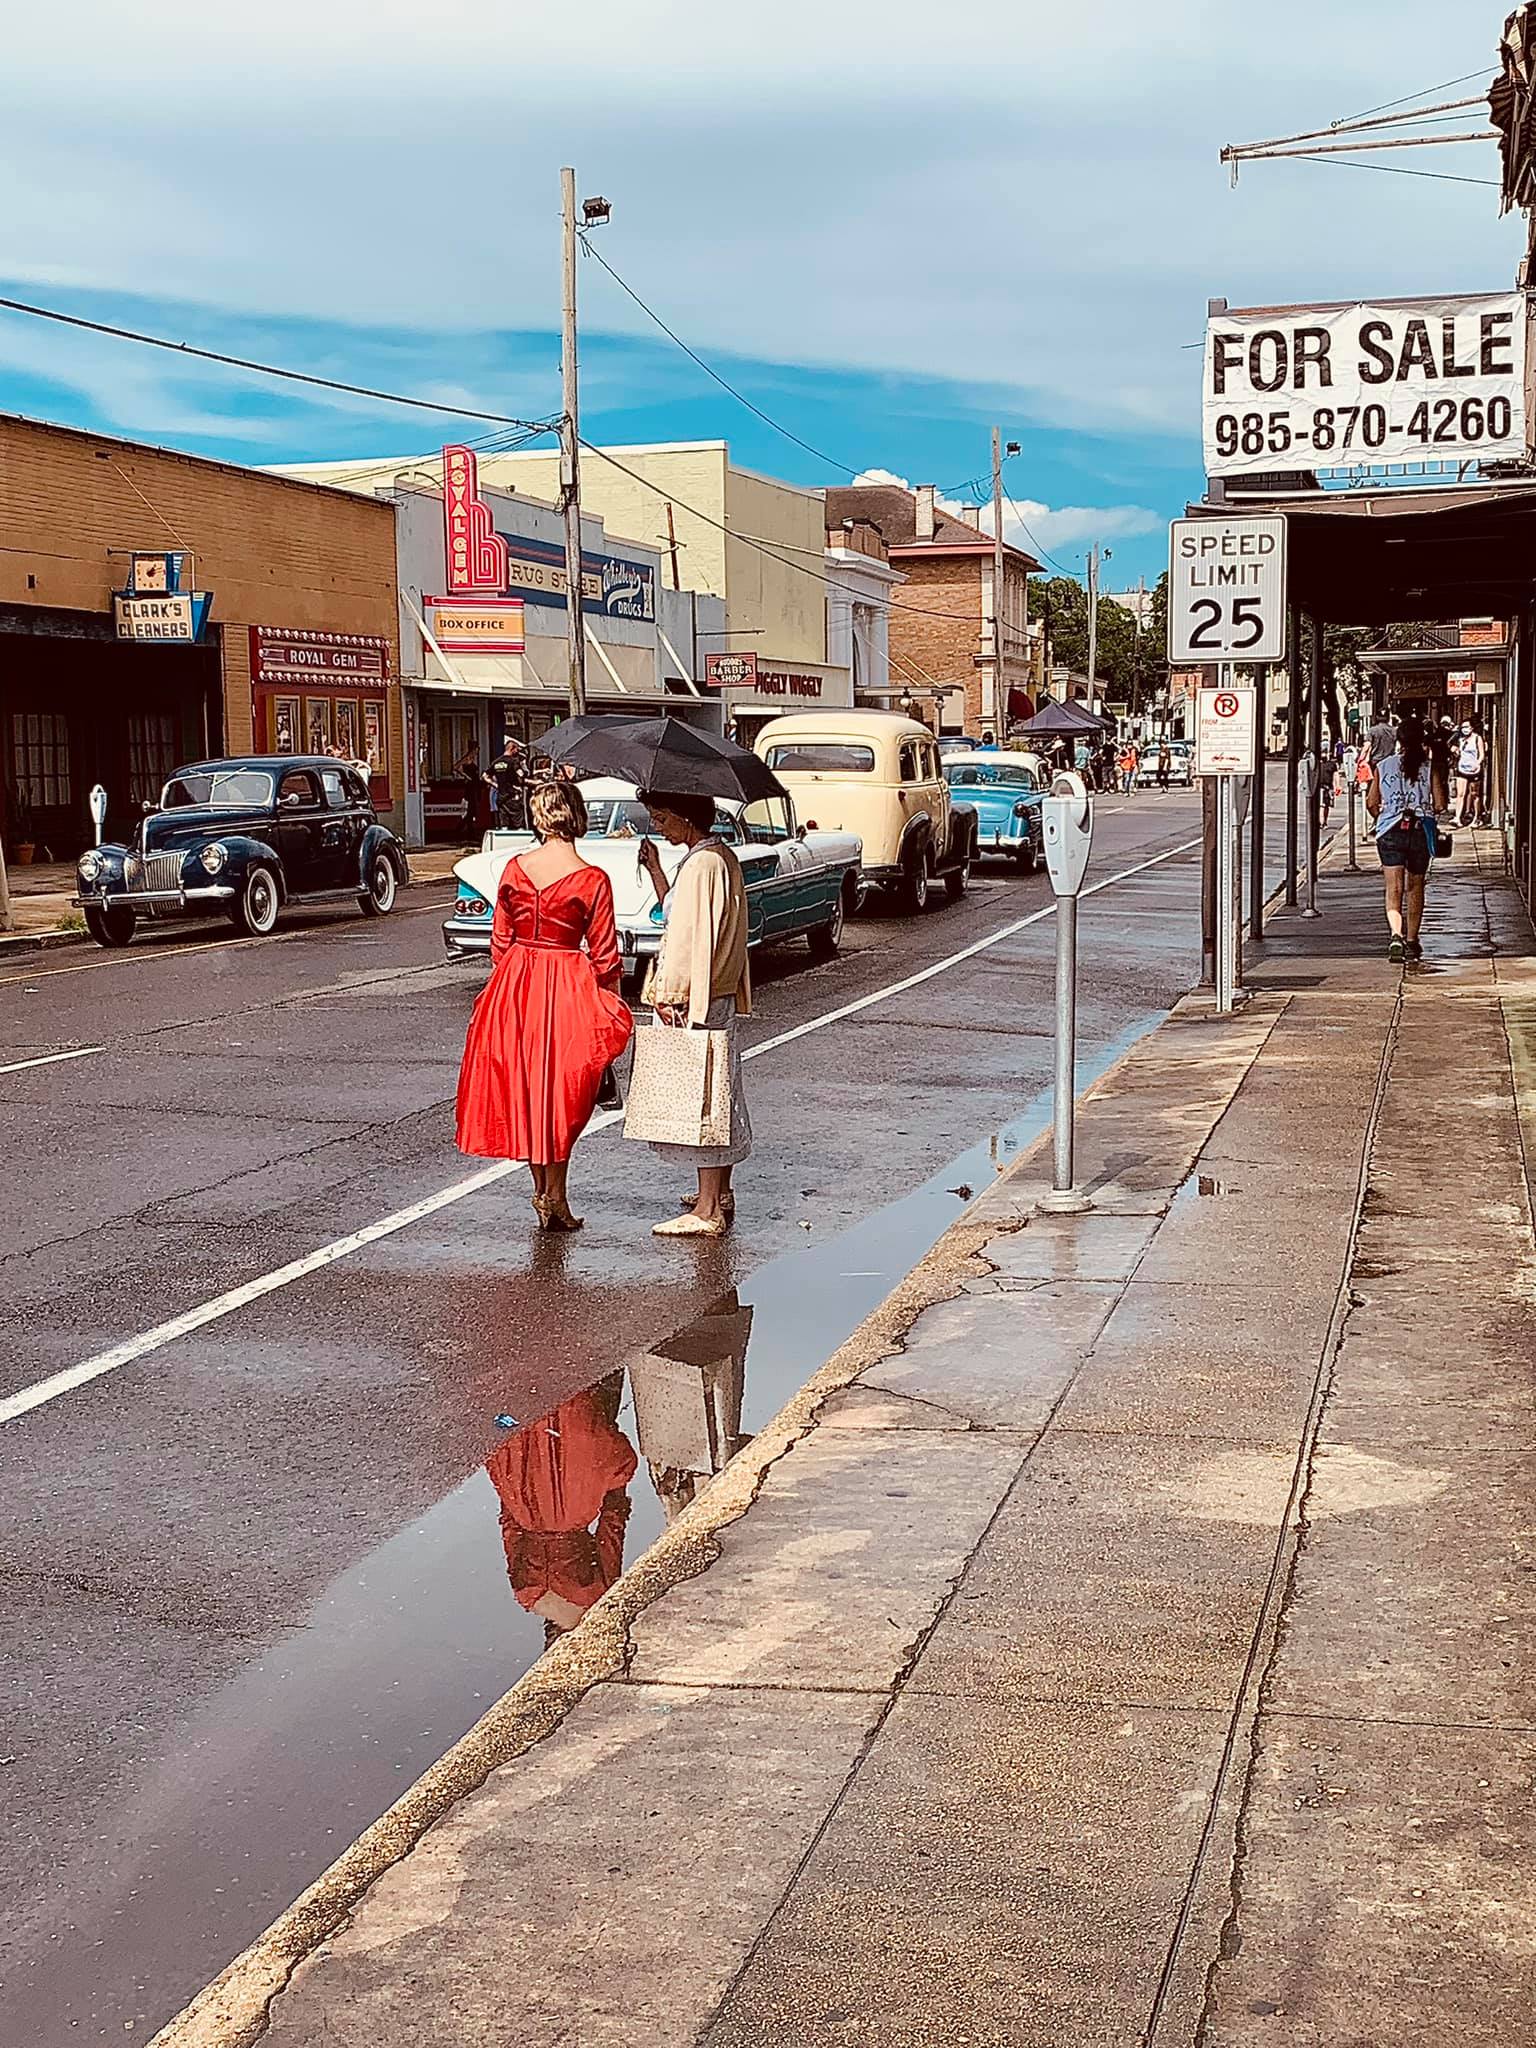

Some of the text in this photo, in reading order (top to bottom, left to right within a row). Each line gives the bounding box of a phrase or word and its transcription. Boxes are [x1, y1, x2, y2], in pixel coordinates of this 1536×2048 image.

[1213, 312, 1514, 395] FOR SALE
[1215, 395, 1512, 457] 985-870-4260
[450, 453, 469, 584] ROYAL GEM
[1180, 533, 1276, 558] SPEED
[510, 563, 599, 597] RUG STRE
[1190, 563, 1265, 587] LIMIT
[122, 601, 183, 618] CLARK'S
[617, 600, 642, 618] DRUGS
[118, 622, 188, 637] CLEANERS
[439, 618, 505, 630] BOX OFFICE
[1188, 596, 1265, 650] 25
[289, 649, 357, 668] ROYAL GEM
[710, 664, 753, 676] BARBER
[720, 674, 742, 683] SHOP
[754, 671, 823, 698] PIGGLY WIGGLY
